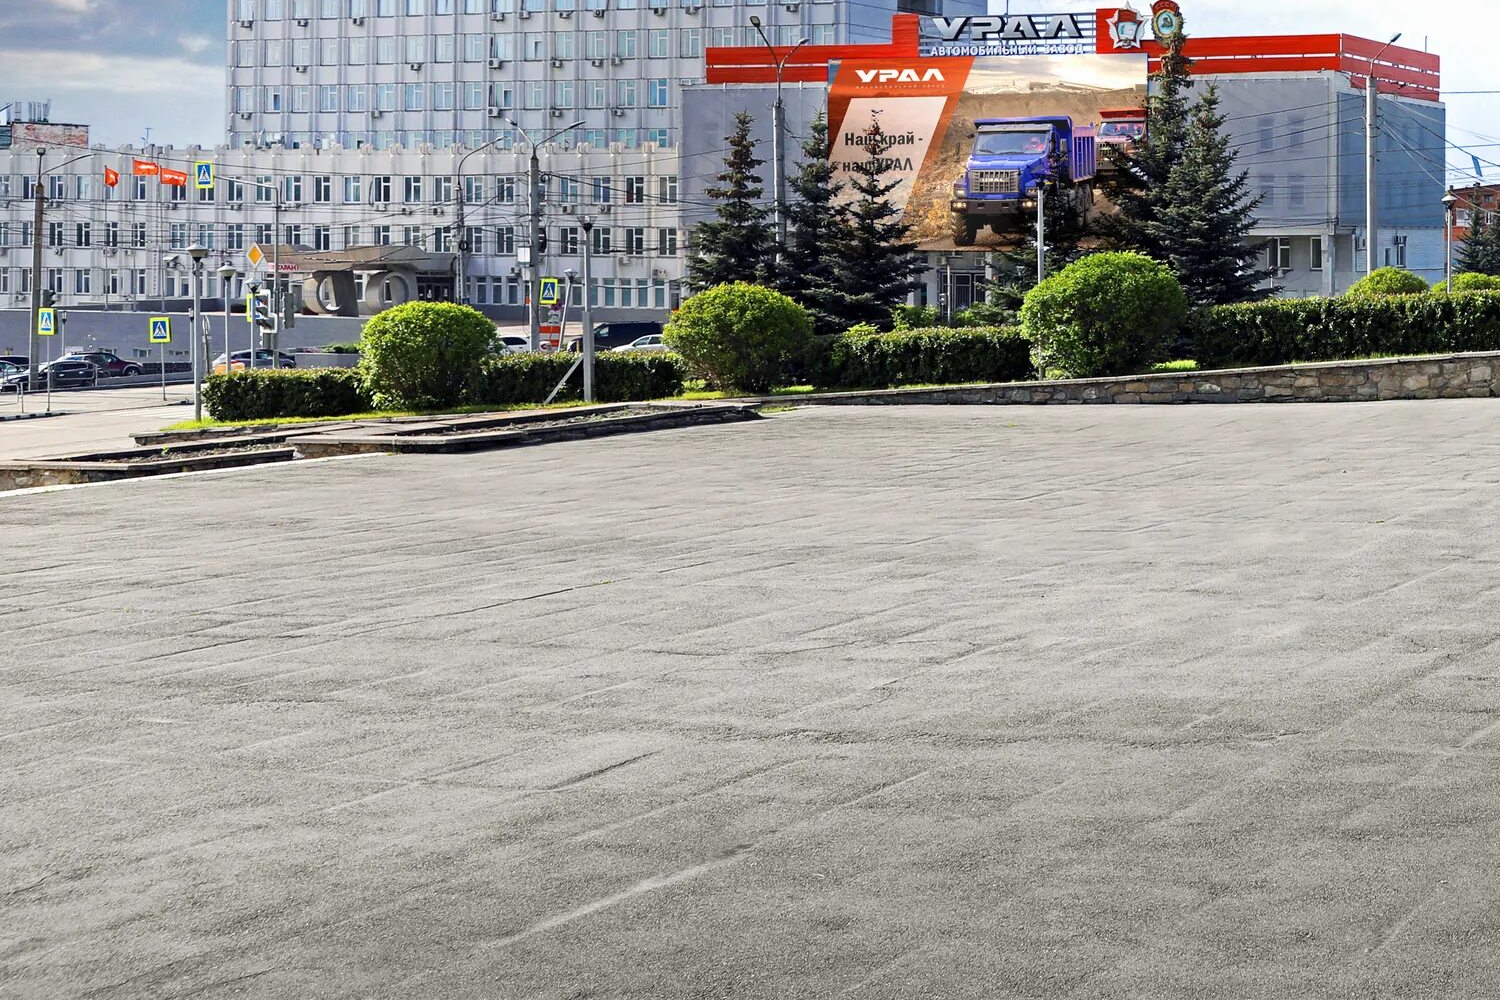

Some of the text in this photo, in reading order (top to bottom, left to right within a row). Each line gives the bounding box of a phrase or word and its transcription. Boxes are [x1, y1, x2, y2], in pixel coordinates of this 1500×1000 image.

[931, 14, 1084, 41] УРАЛ
[931, 43, 1084, 56] АВТОМОБИЛЬНЫЙ ЗАВОД
[855, 68, 945, 82] УРАЛ
[880, 131, 914, 147] край
